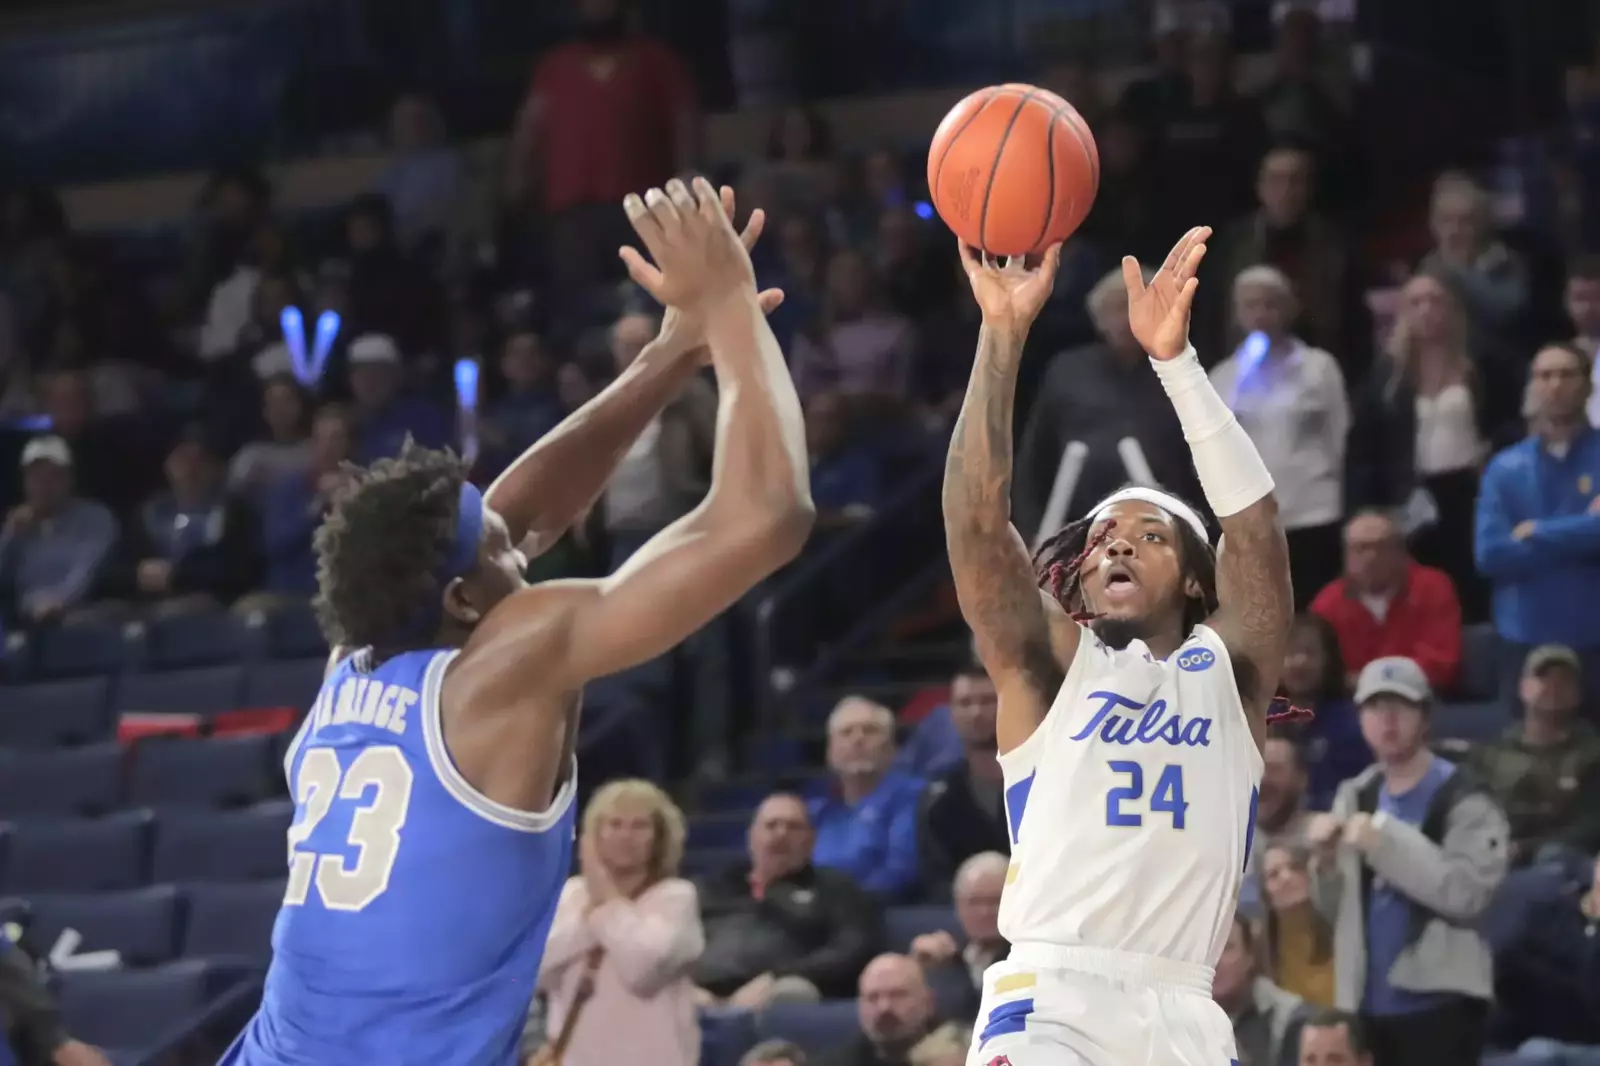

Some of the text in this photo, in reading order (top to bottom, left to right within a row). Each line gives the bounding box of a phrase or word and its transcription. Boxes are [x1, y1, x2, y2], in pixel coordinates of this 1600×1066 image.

[1180, 651, 1213, 668] DOC
[1069, 690, 1212, 747] Tulsa
[1106, 760, 1189, 829] 24
[283, 746, 413, 911] 23
